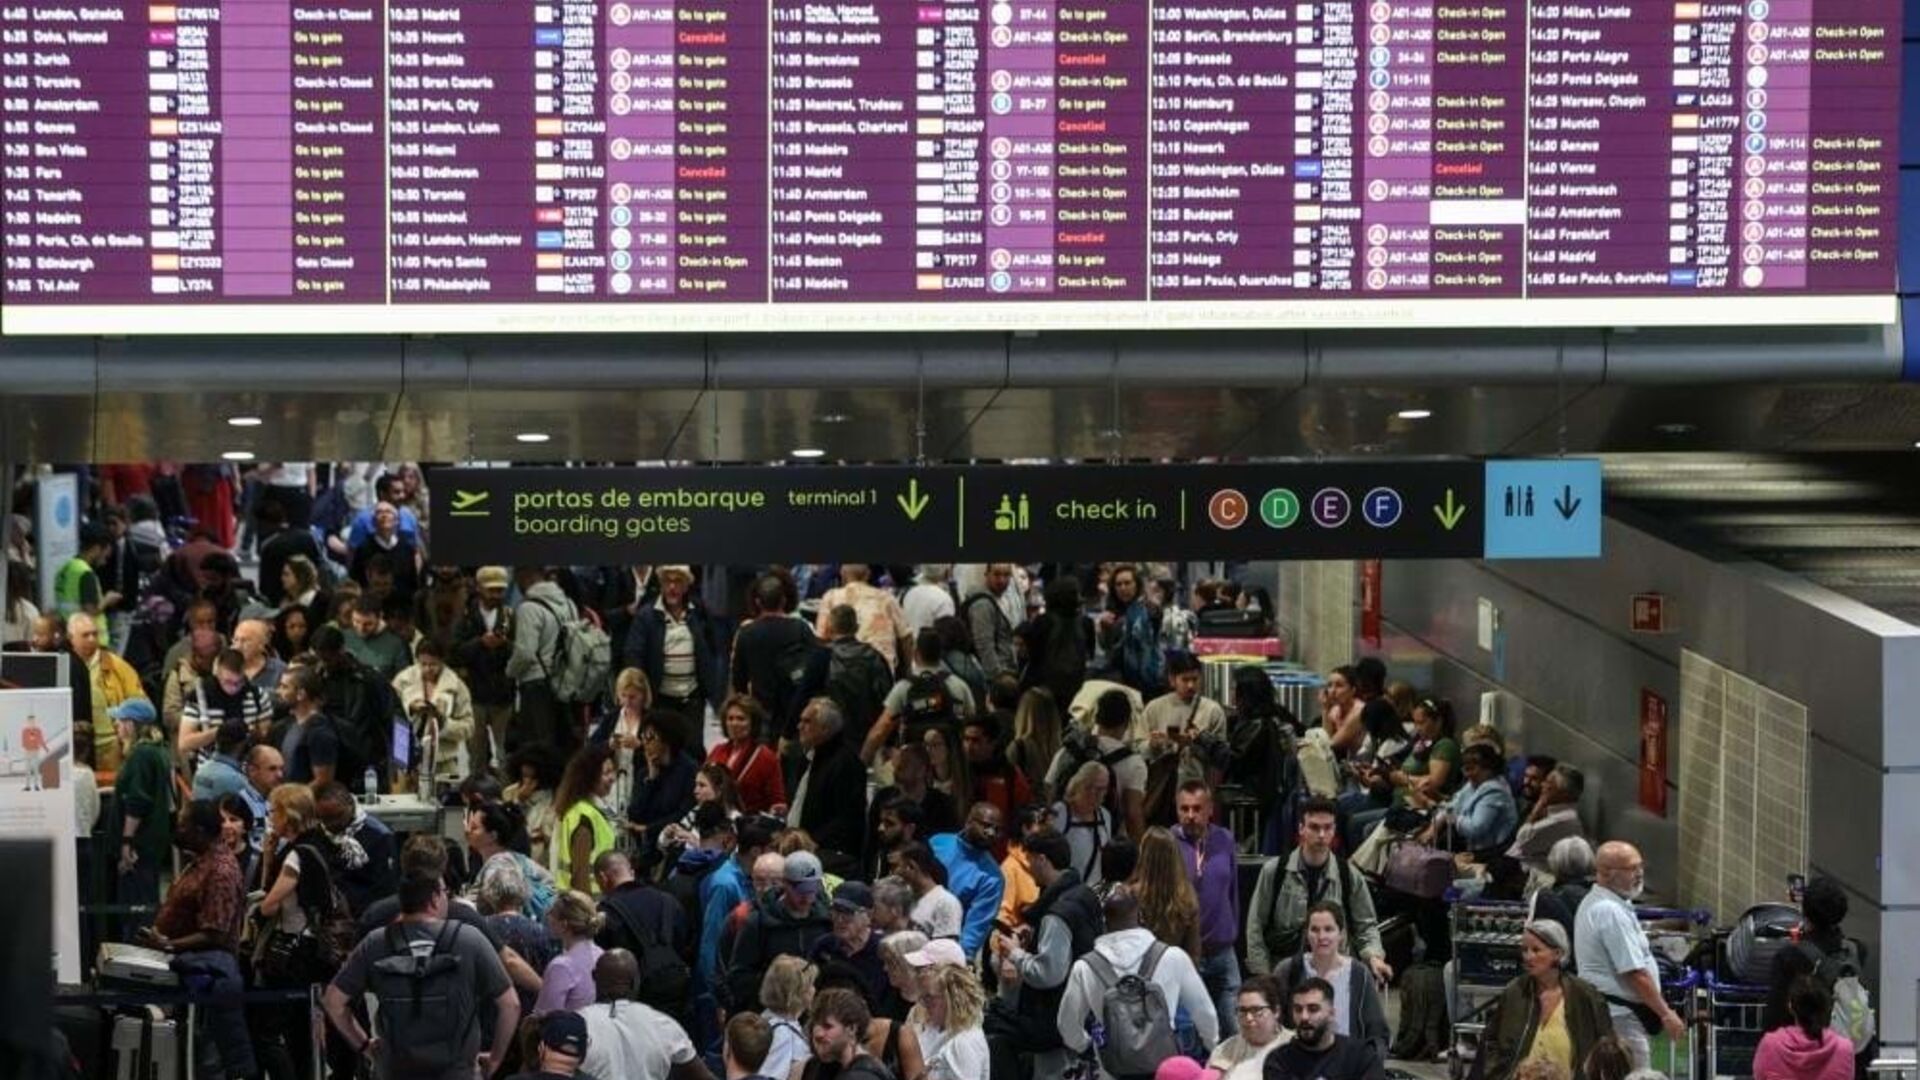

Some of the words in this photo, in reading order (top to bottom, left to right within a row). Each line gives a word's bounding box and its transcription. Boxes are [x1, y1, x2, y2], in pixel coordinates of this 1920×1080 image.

[515, 488, 594, 510] portas
[601, 489, 631, 508] de
[638, 489, 766, 510] embarque
[788, 490, 866, 505] terminal
[870, 490, 877, 505] 1
[1056, 500, 1127, 519] check
[1136, 500, 1156, 519] in
[1221, 498, 1237, 519] C
[1273, 498, 1290, 519] D
[1324, 498, 1339, 519] E
[1376, 498, 1389, 519] F
[514, 515, 619, 538] boarding
[626, 517, 691, 538] gates
